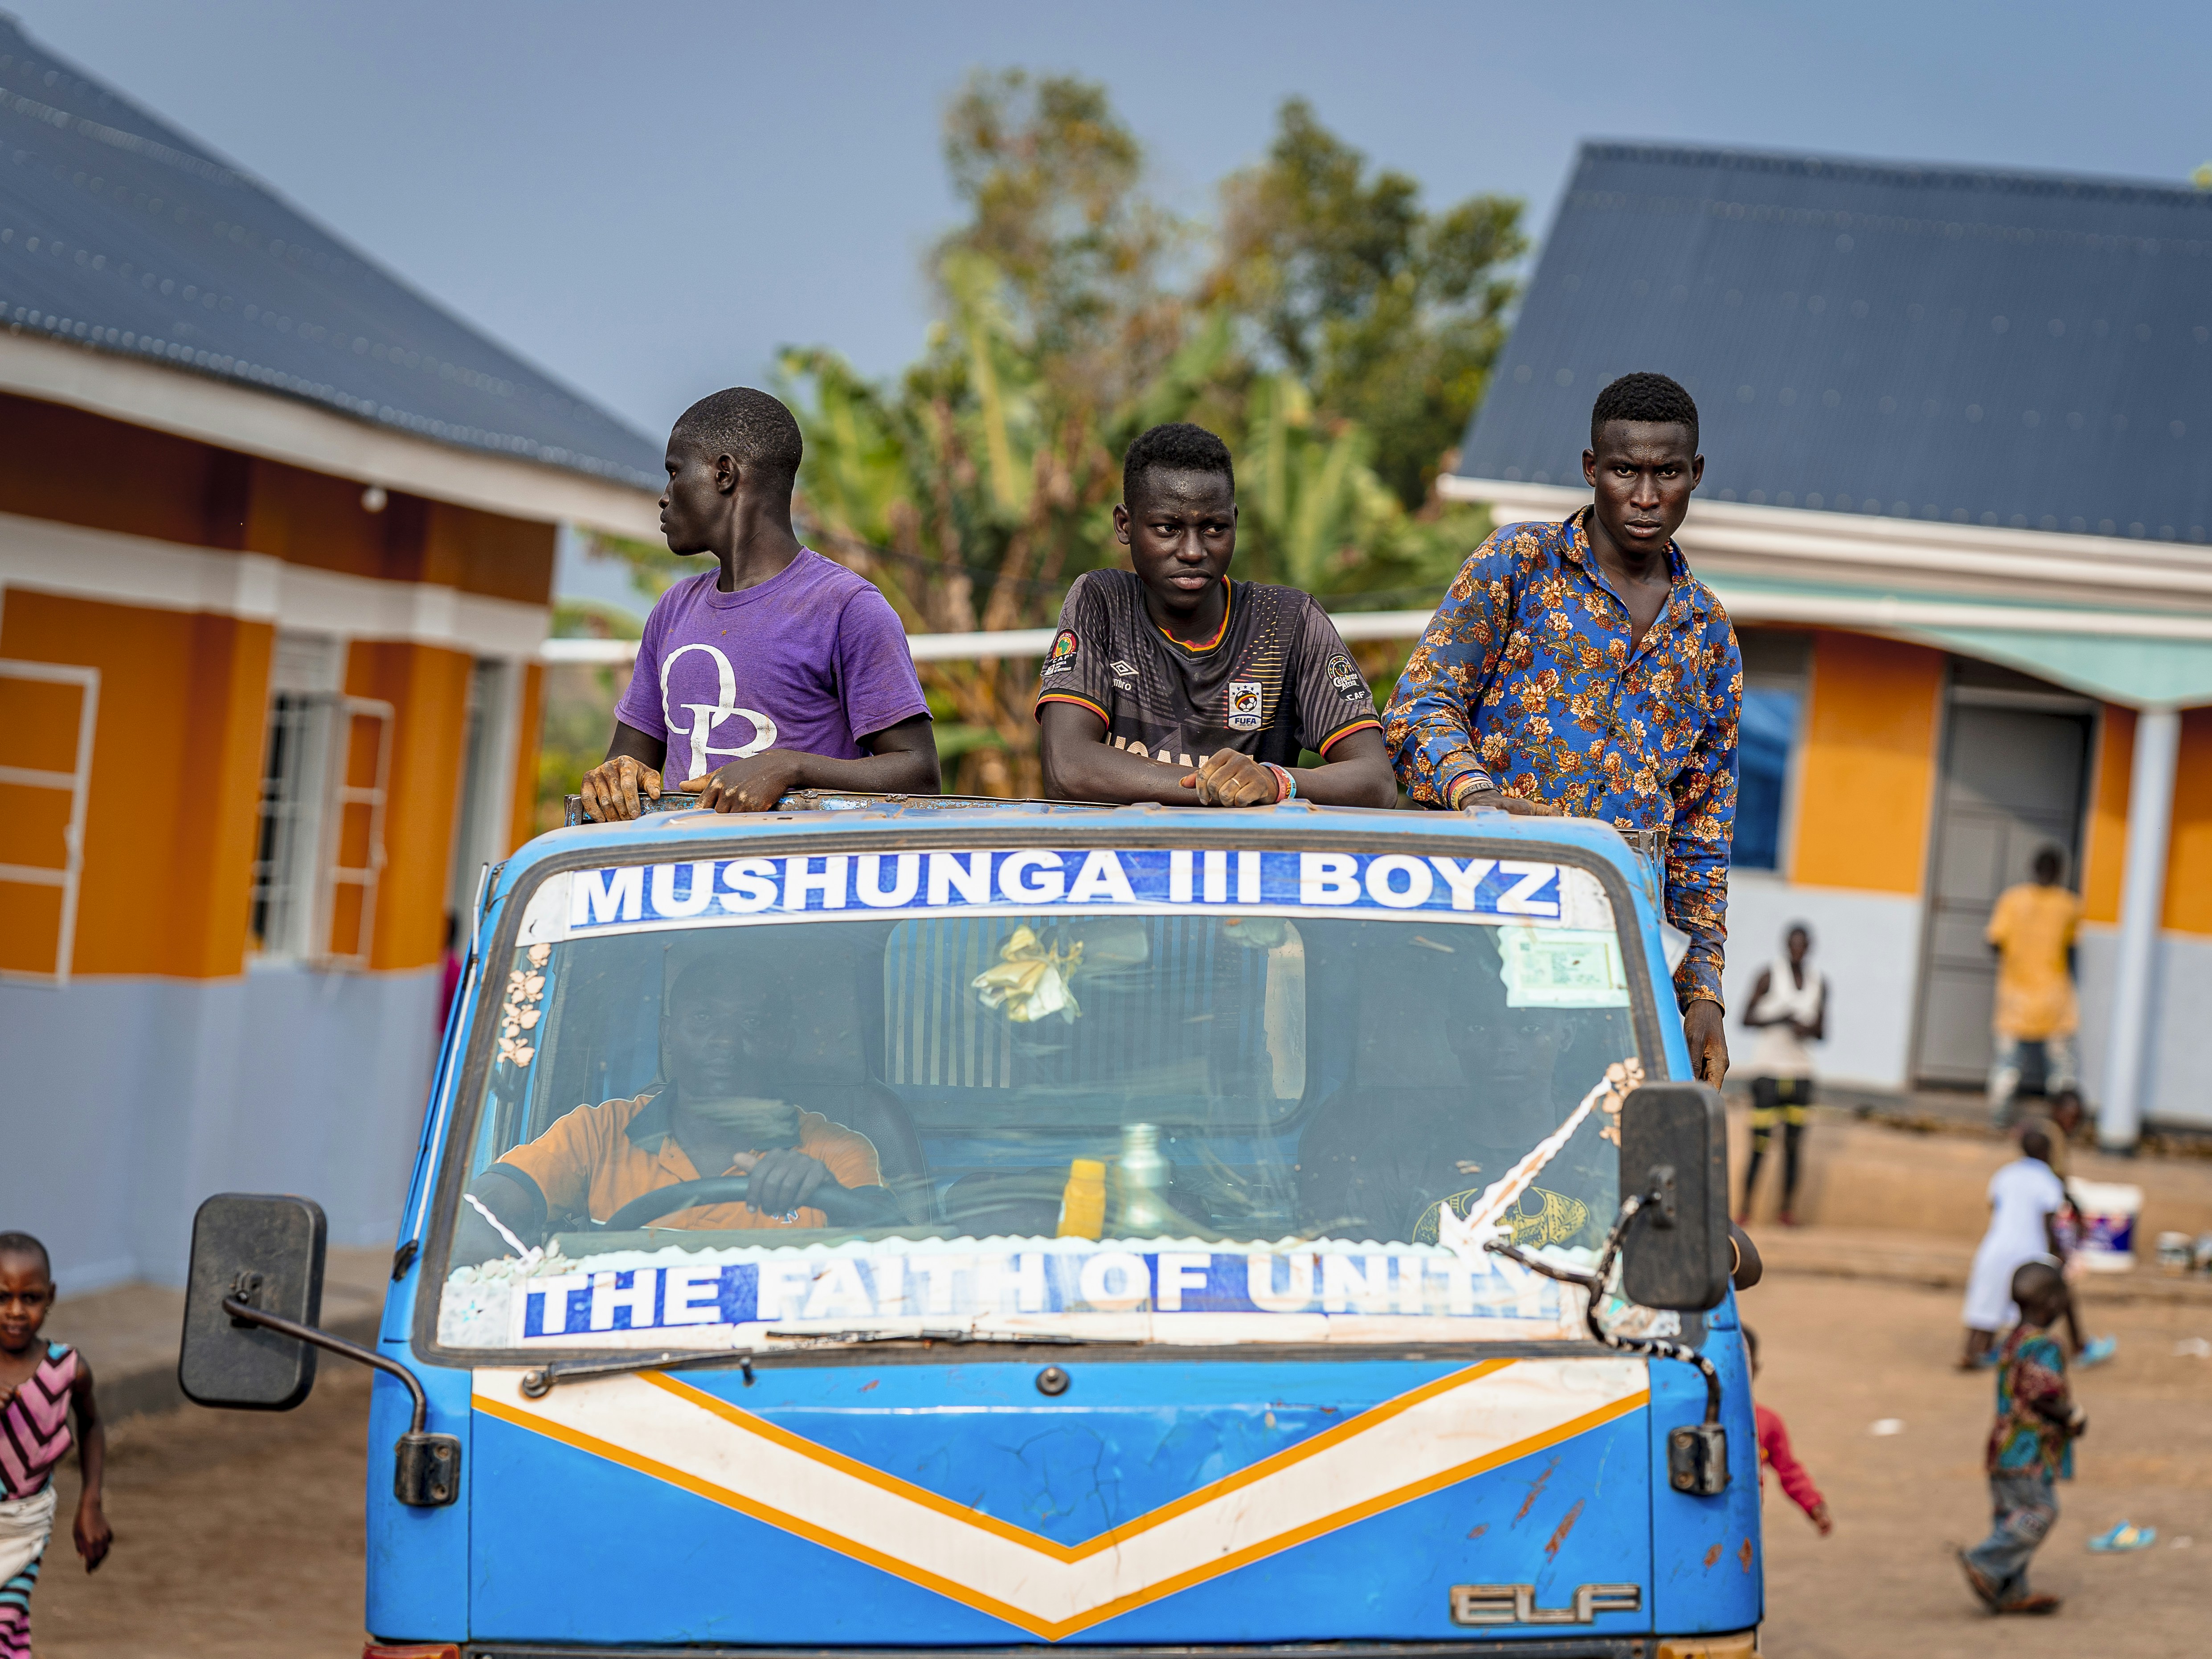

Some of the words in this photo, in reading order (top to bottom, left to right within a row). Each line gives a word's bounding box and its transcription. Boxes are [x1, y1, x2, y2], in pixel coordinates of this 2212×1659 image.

[1052, 654, 1070, 663] CAF
[1112, 678, 1132, 691] mbro
[1333, 673, 1358, 687] Celebrate
[1341, 679, 1357, 690] Africa
[1346, 691, 1364, 701] CAF
[570, 849, 1137, 927] MUSHUNGA
[1169, 850, 1261, 903] III
[1300, 851, 1559, 916] BOYZ
[528, 1266, 723, 1333] THE
[757, 1253, 1044, 1320] FAITH
[1078, 1252, 1211, 1312] OF
[1248, 1252, 1559, 1319] UNITY
[1449, 1584, 1642, 1626] ELF
